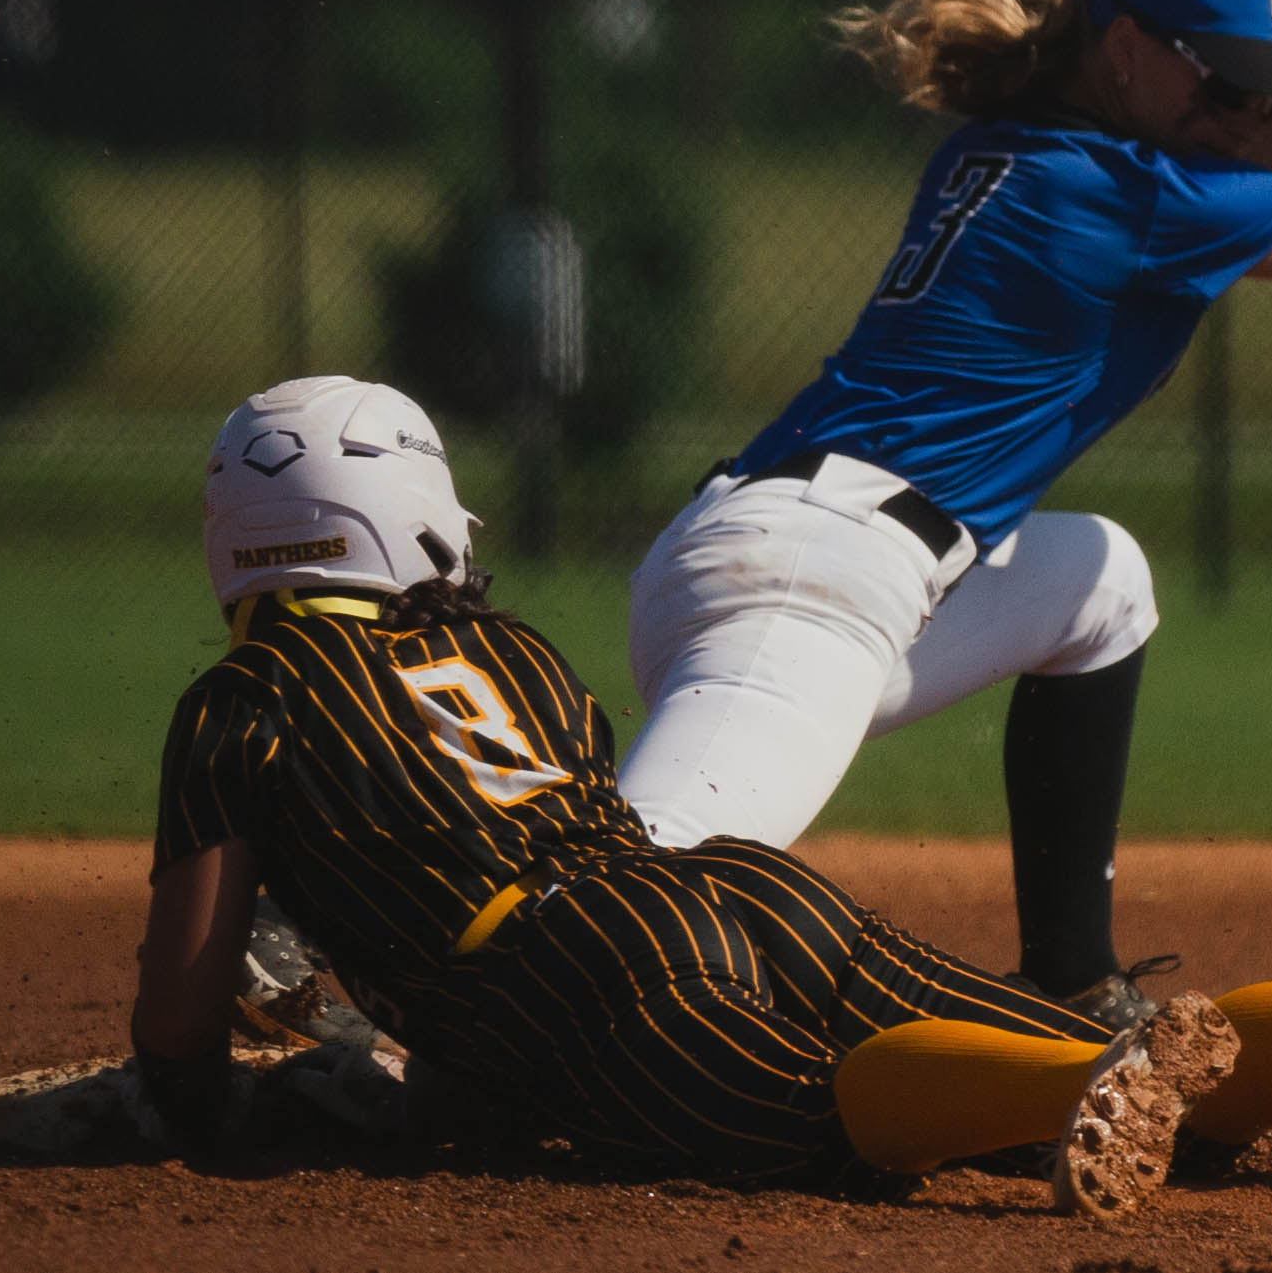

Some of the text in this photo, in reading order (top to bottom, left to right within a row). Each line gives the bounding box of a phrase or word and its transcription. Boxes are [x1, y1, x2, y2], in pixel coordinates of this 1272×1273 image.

[876, 152, 1015, 306] 3
[232, 536, 348, 570] PANTHERS
[387, 655, 576, 808] 8
